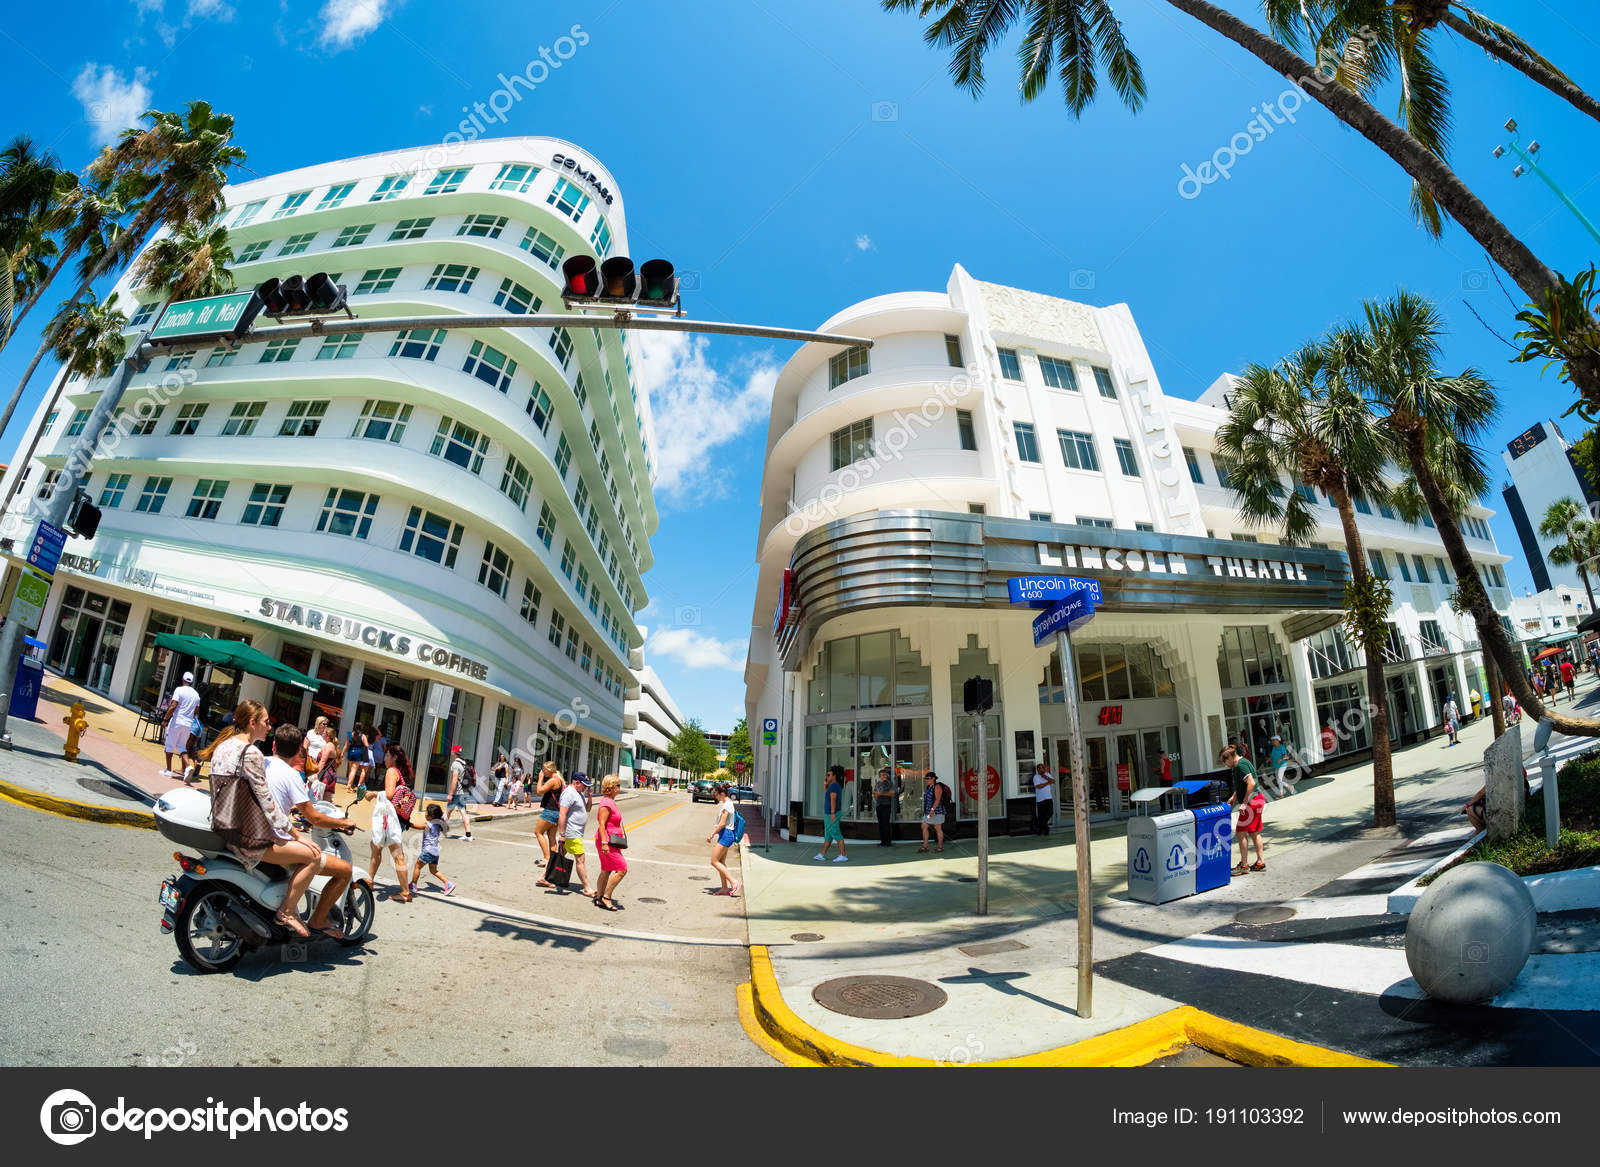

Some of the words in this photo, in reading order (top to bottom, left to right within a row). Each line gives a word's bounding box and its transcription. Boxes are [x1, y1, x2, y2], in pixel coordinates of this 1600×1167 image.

[552, 153, 614, 206] COMPASS
[159, 308, 195, 329] Lincoln
[196, 305, 213, 325] Rd
[215, 301, 242, 322] Mall
[1037, 543, 1189, 575] LINCOLN
[1206, 556, 1308, 581] THEATRE
[1018, 578, 1066, 591] Lincoln
[1068, 578, 1099, 593] Road
[1027, 591, 1043, 599] 600
[1069, 600, 1082, 610] AVE
[259, 597, 411, 655] STARBUCKS
[416, 643, 489, 681] COFFEE
[1168, 752, 1180, 760] 551
[1202, 806, 1225, 814] Trash
